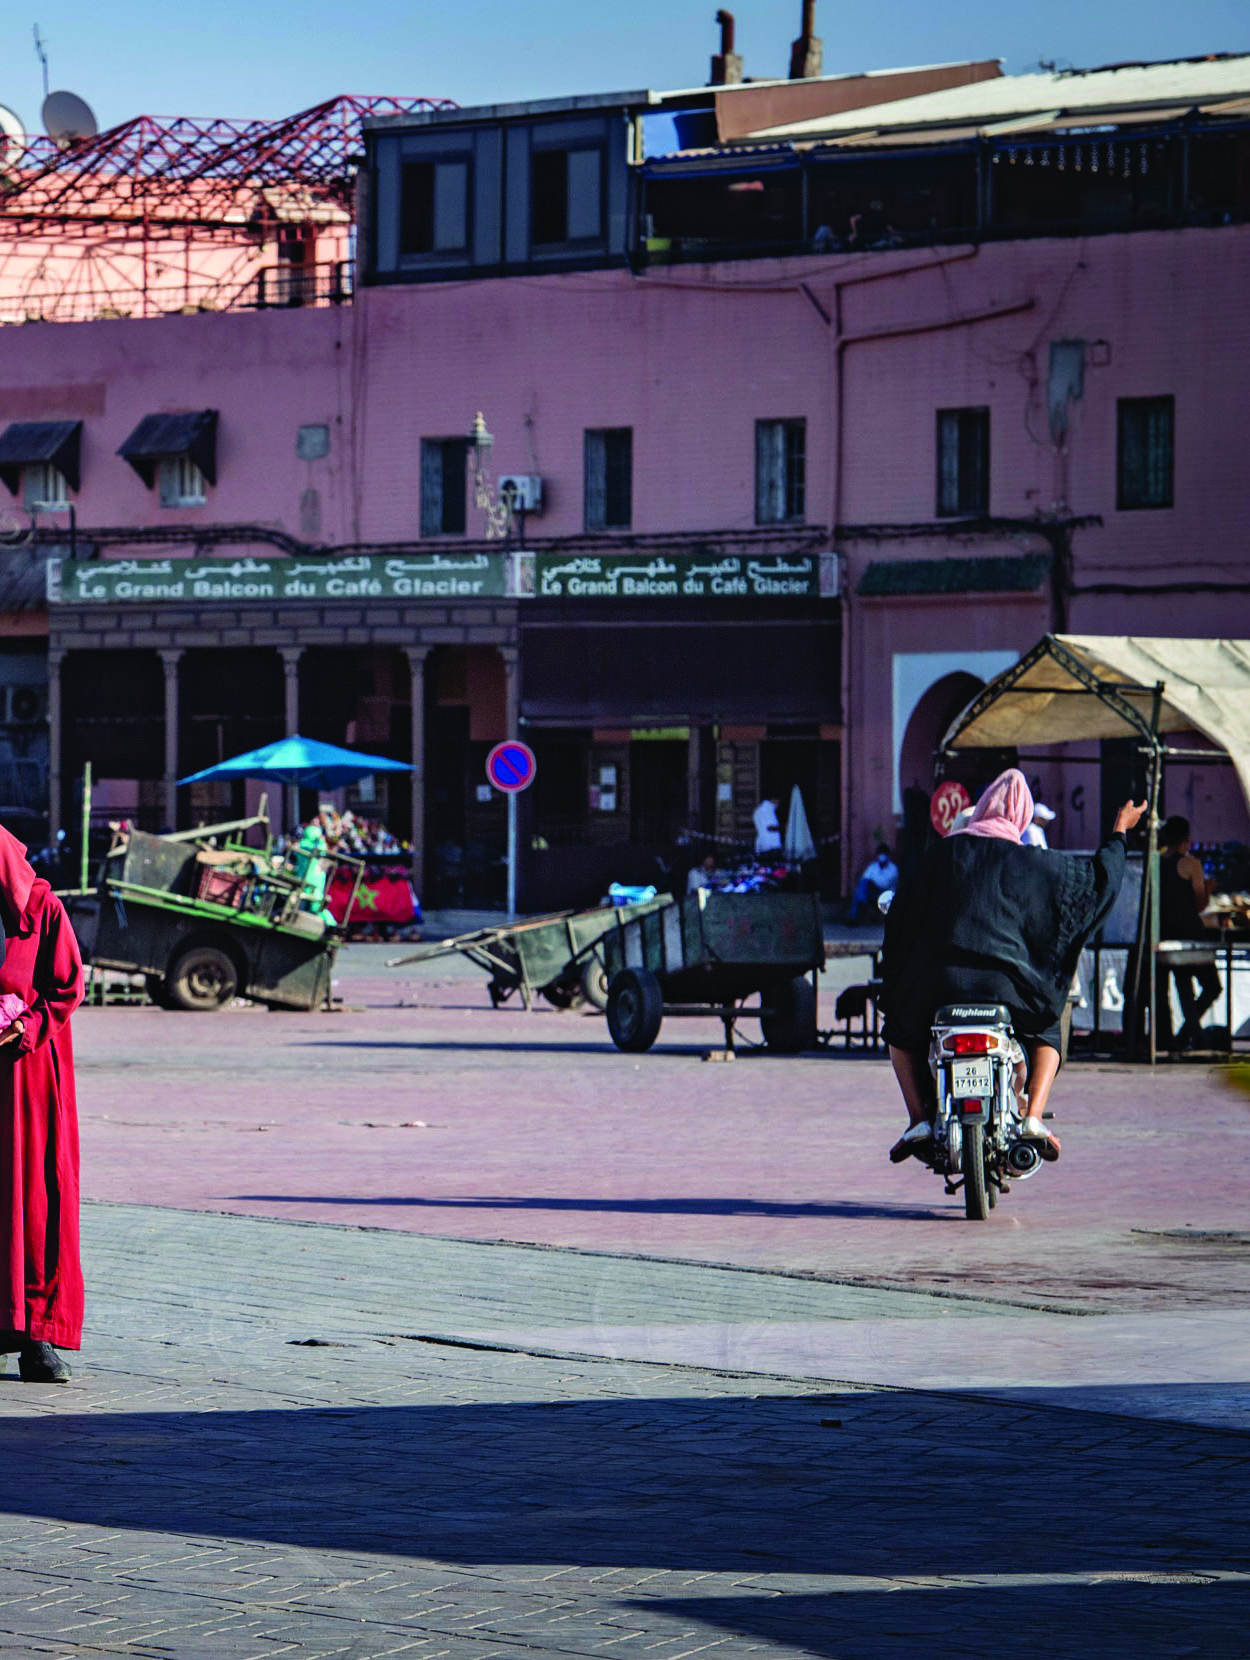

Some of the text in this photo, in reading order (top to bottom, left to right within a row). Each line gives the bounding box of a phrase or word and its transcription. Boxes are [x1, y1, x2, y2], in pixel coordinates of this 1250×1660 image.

[284, 556, 372, 576] الكبير
[384, 554, 490, 578] السطح
[685, 557, 741, 577] الكبير
[79, 578, 483, 598] Le Grand Balcon du Café Glacier
[542, 576, 809, 595] Le Grand Balcon du Café Glacier
[951, 1007, 997, 1018] Highland
[966, 1066, 977, 1076] 26
